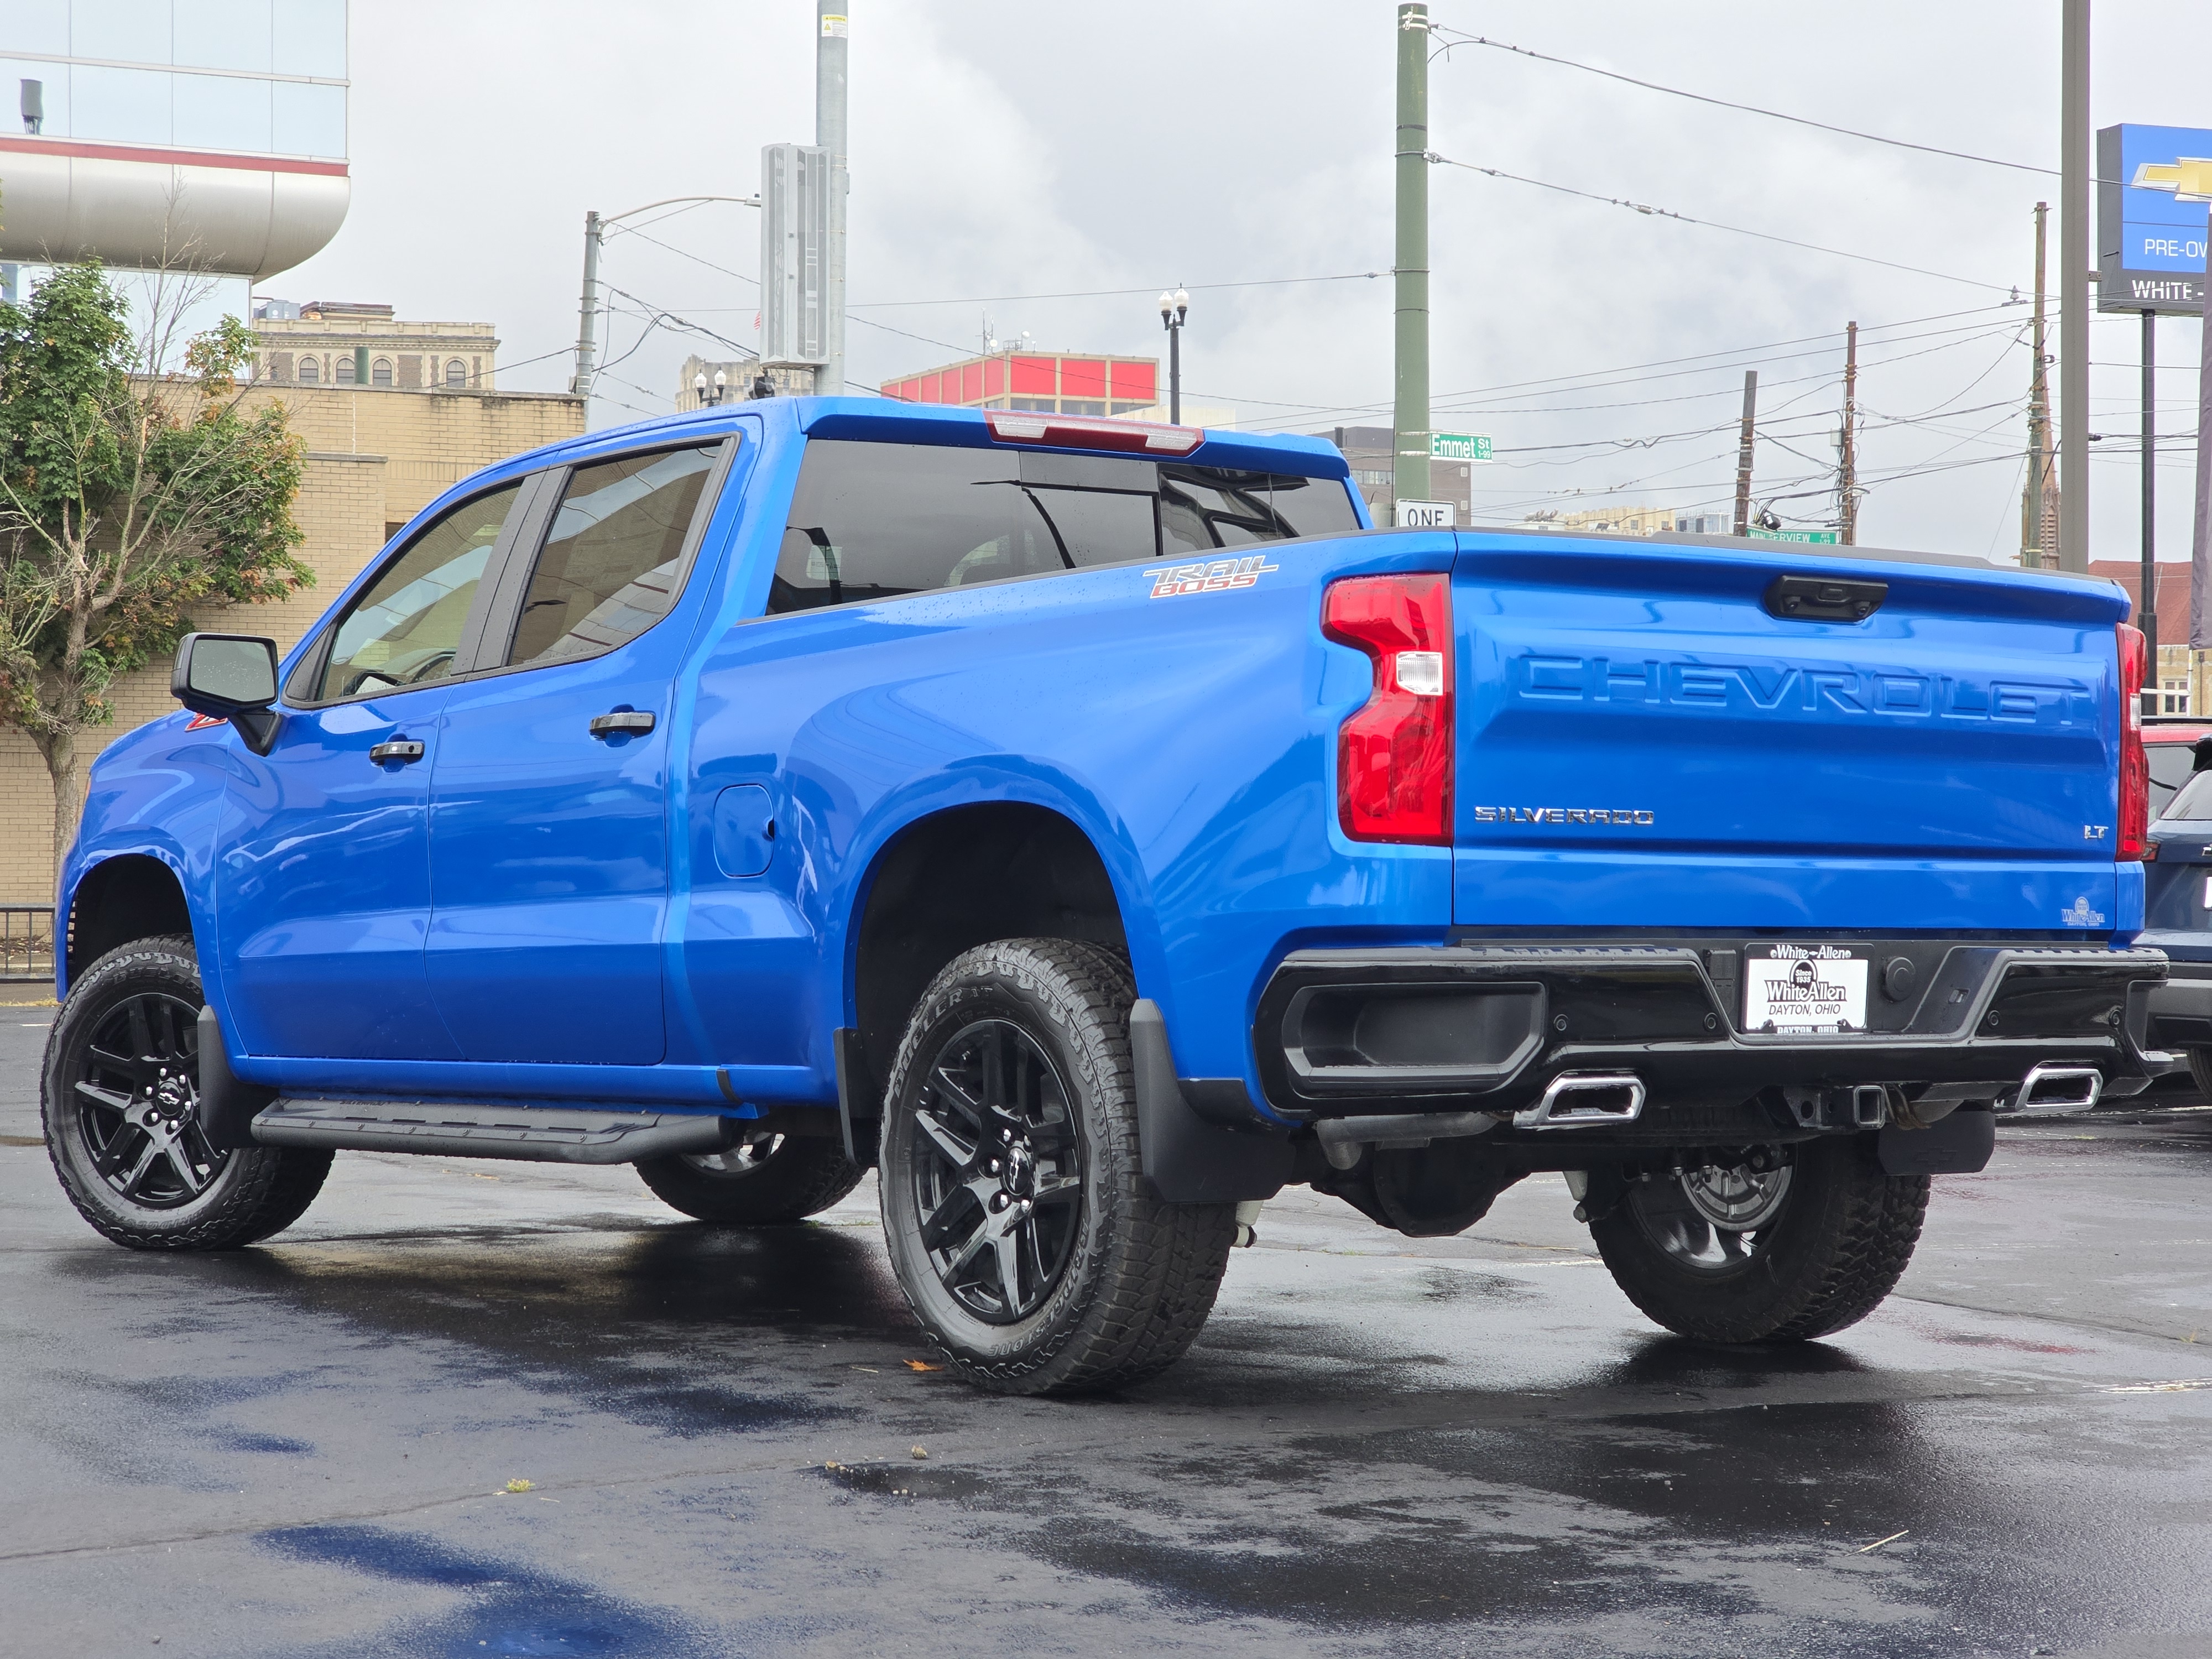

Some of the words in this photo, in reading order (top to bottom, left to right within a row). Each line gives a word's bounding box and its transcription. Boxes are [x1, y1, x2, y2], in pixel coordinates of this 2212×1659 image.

[1432, 434, 1476, 458] Emmet
[1478, 438, 1490, 449] St
[1407, 508, 1444, 526] ONE
[1750, 530, 1766, 539] MAIN
[1773, 533, 1811, 543] ERVIEW
[1142, 555, 1280, 583] TRAIL
[1150, 573, 1259, 599] BOSS
[1519, 654, 2091, 725] CHEVROLET
[1474, 806, 1655, 825] SILVERADO
[2084, 825, 2109, 839] LT
[1769, 1004, 1812, 1016] DAYTON,
[1815, 1004, 1841, 1015] OHIO
[894, 988, 963, 1098] DUELER
